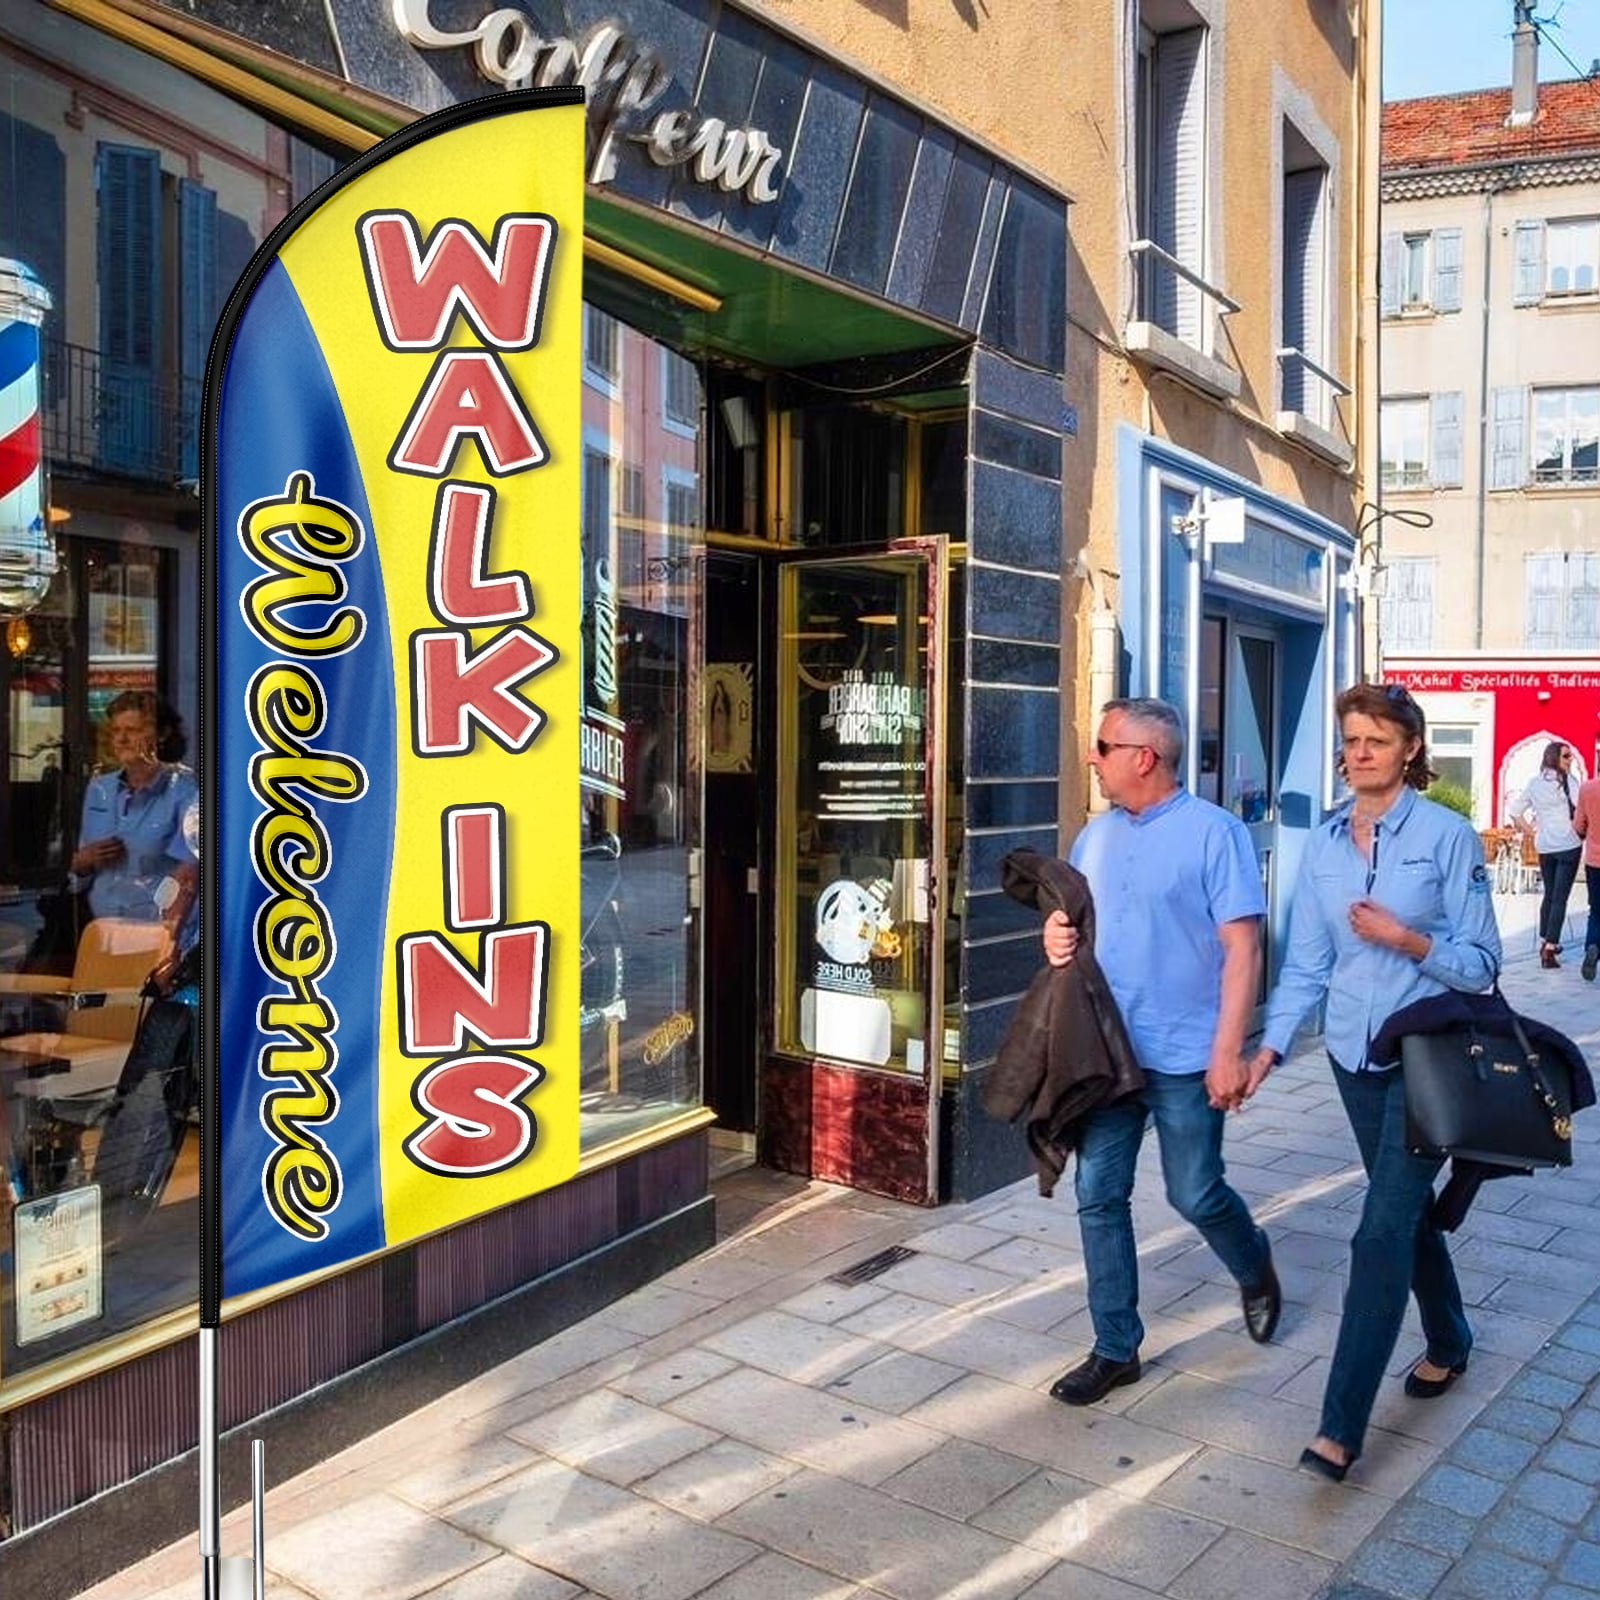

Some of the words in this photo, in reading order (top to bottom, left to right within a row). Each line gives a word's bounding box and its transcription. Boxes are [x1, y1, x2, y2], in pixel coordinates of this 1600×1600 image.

[356, 208, 561, 757] WALK
[238, 472, 369, 1240] Welcome
[580, 722, 625, 784] RBIER
[396, 802, 551, 1178] INS
